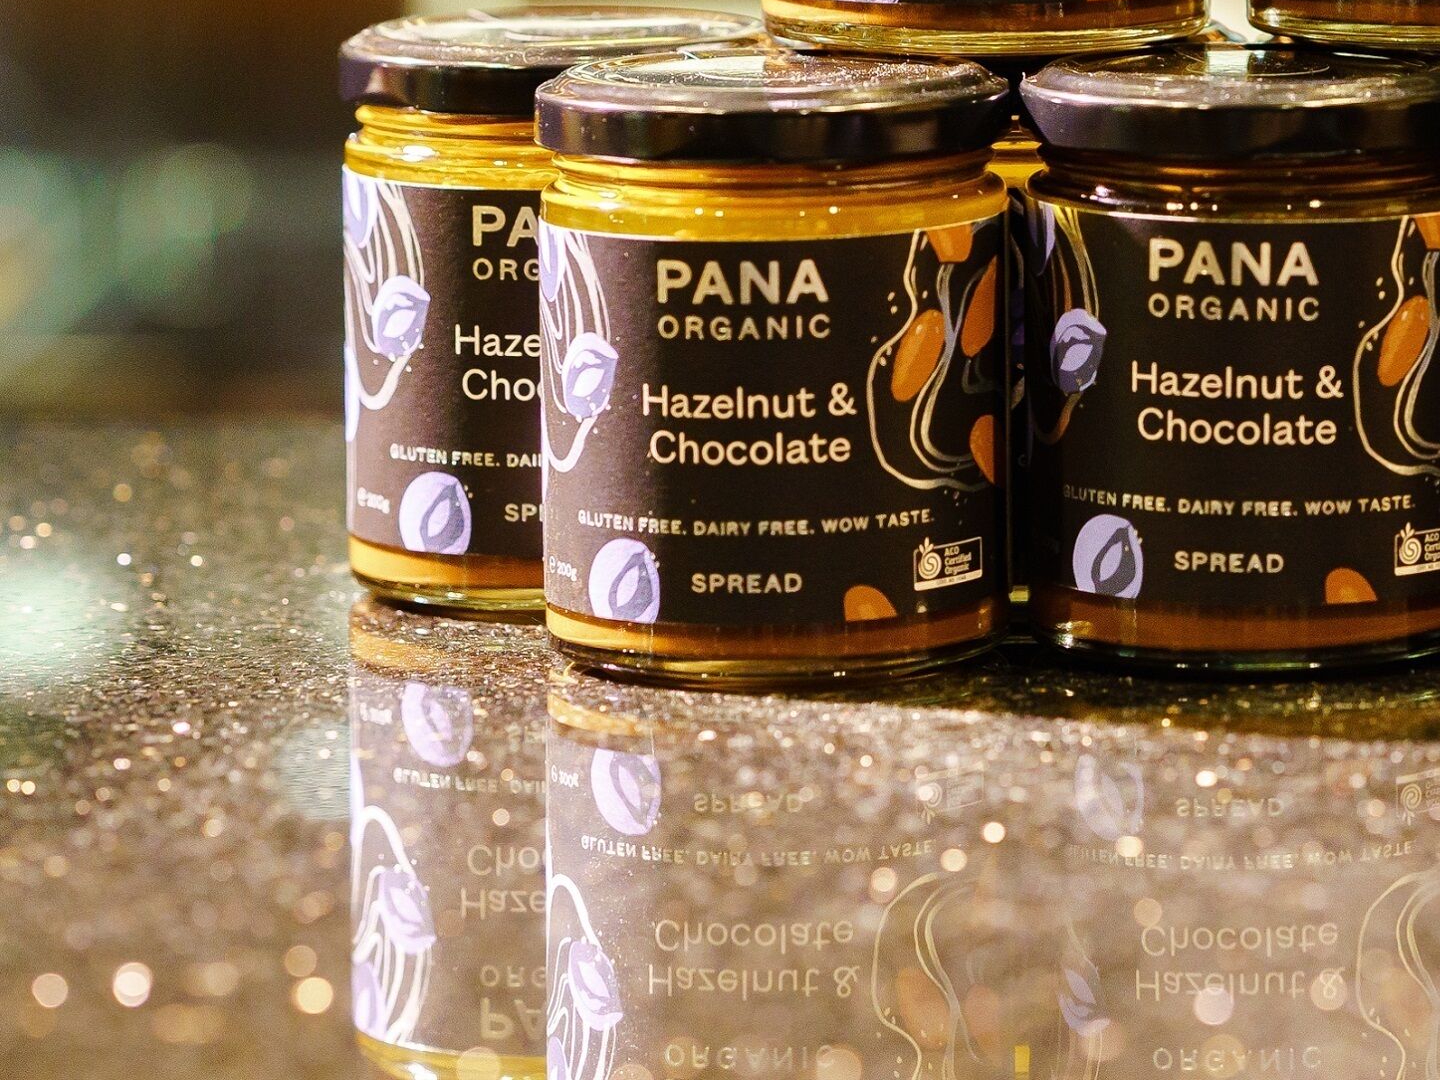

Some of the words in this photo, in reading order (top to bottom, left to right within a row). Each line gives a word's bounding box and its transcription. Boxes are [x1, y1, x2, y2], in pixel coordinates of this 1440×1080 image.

[472, 206, 540, 248] PA
[1149, 237, 1319, 286] PANA
[657, 259, 829, 305] PANA
[1148, 293, 1320, 321] ORGANIC
[454, 324, 540, 358] Haze
[658, 314, 830, 341] ORGANIC
[1131, 360, 1303, 400] Hazelnut
[1315, 364, 1344, 399] &
[642, 384, 816, 420] Hazelnut
[830, 383, 856, 416] &
[1137, 407, 1337, 446] Chocolate
[390, 445, 447, 466] GLUTEN
[451, 451, 500, 469] FREE.
[506, 453, 541, 470] DAI
[649, 430, 850, 467] Chocolate
[1122, 492, 1171, 513] FREE.
[1177, 497, 1234, 515] DAIRY
[1242, 500, 1297, 516] FREE.
[1304, 498, 1352, 515] WOW
[1357, 494, 1416, 513] TASTE.
[578, 508, 635, 531] GLUTEN
[638, 513, 686, 537] FREE.
[693, 519, 750, 536] DAIRY
[759, 516, 815, 536] FREE.
[822, 514, 868, 533] WOW
[876, 509, 935, 528] TASTE.
[1174, 550, 1284, 573] SPREAD
[691, 572, 802, 594] SPREAD
